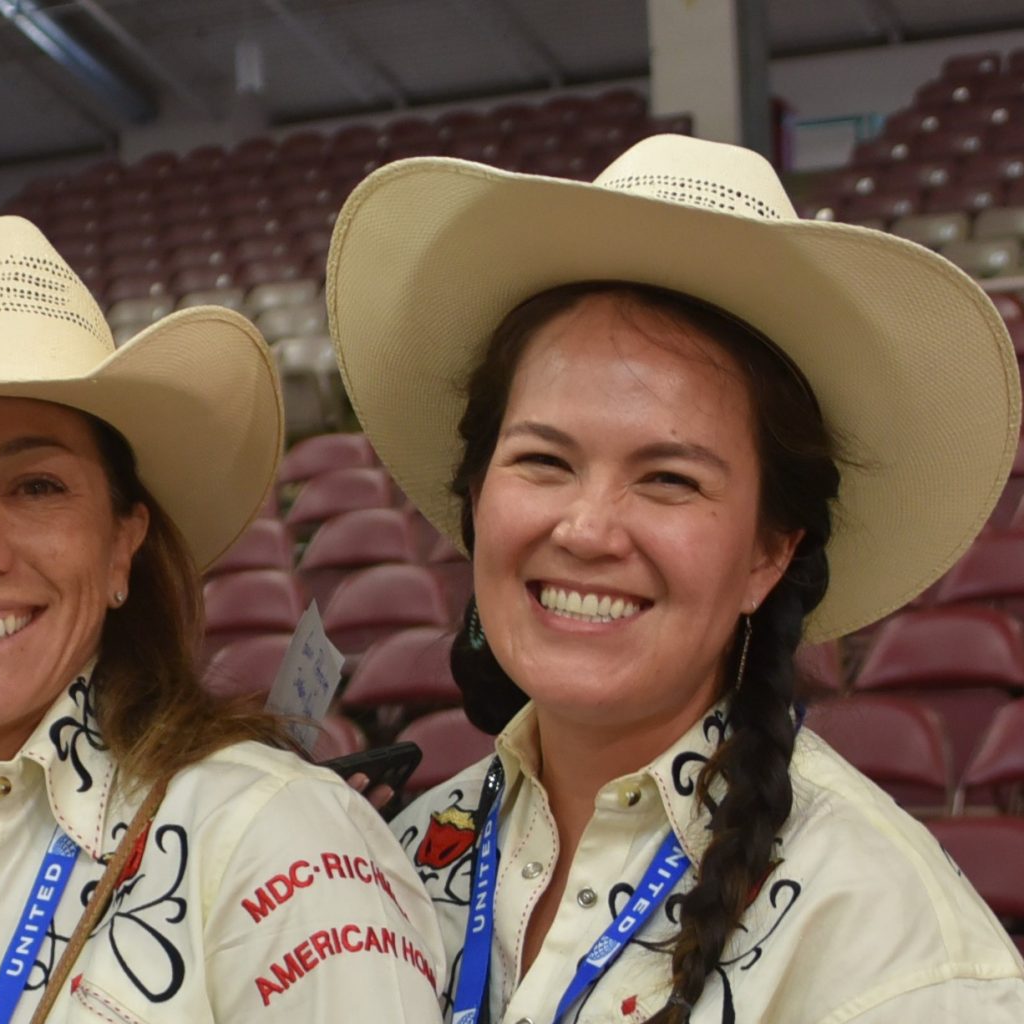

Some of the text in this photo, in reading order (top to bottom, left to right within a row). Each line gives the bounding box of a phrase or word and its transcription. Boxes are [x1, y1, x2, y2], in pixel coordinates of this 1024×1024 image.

[6, 862, 62, 977] UNITED
[473, 819, 494, 933] UNITED
[618, 846, 686, 933] NITED
[255, 924, 398, 1007] AMERICAN
